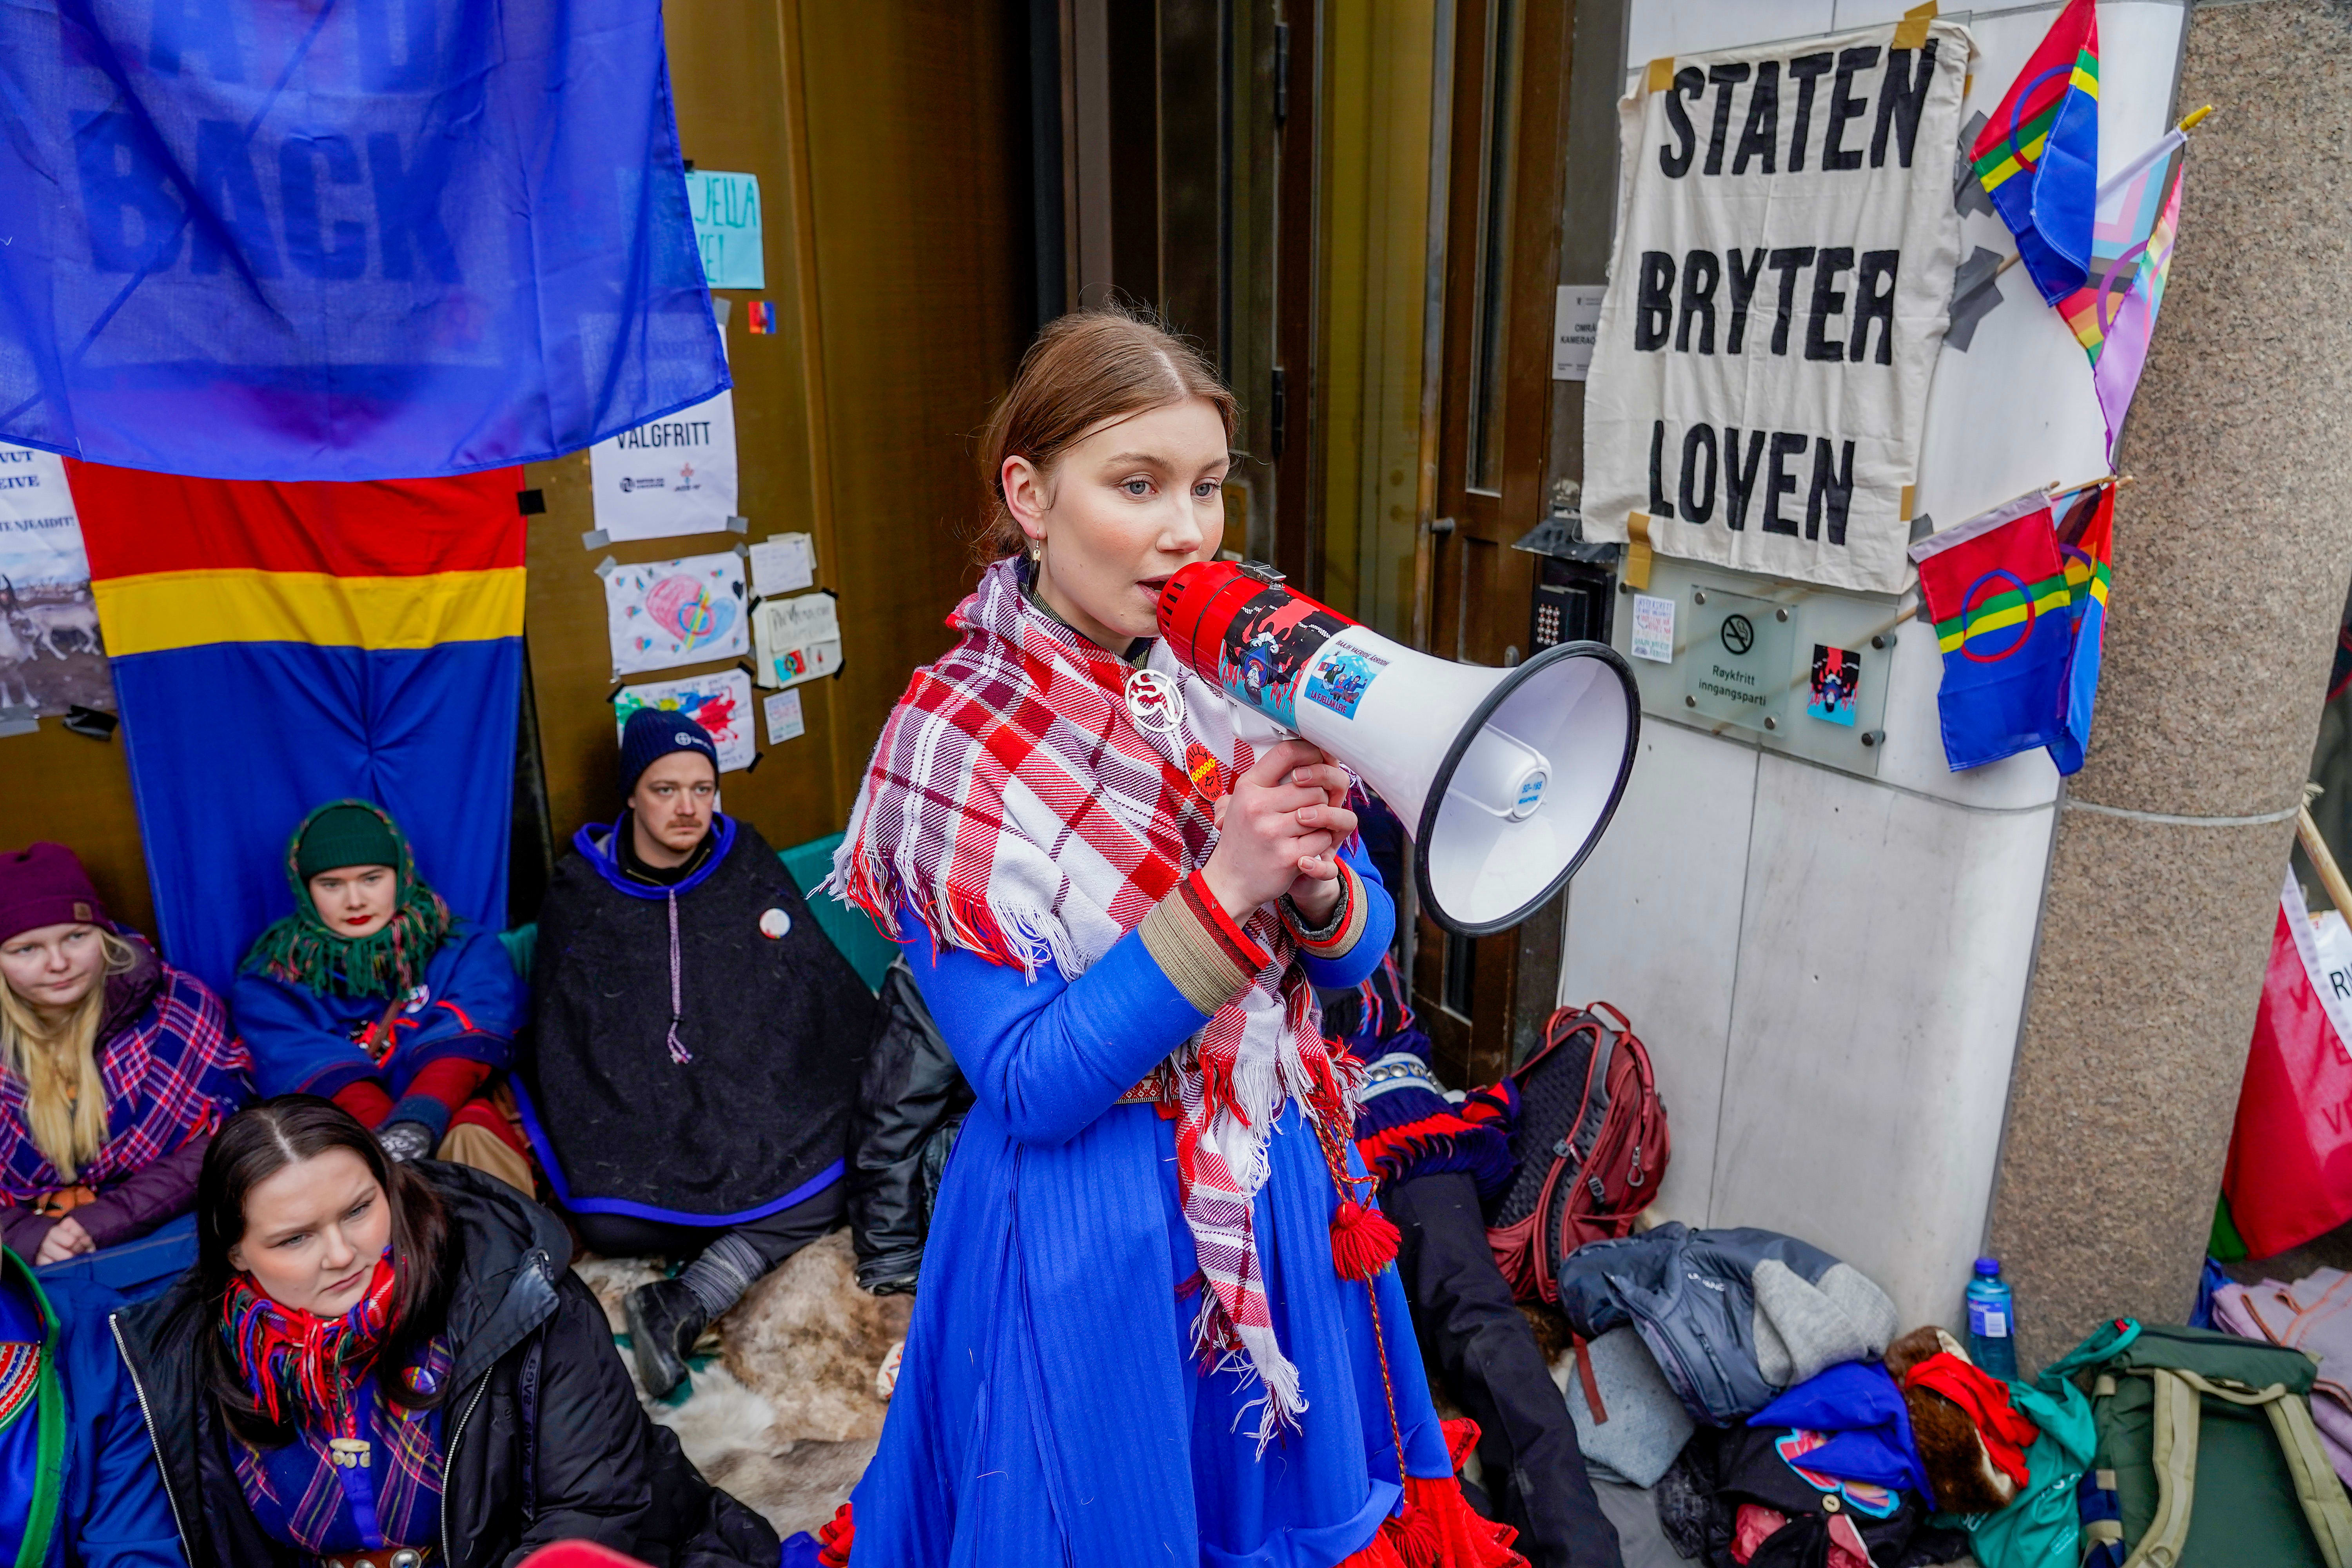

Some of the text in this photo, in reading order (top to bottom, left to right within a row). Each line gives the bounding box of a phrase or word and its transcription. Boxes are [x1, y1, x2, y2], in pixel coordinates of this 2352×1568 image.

[1660, 38, 1939, 179] STATEN
[70, 109, 465, 284] BACK
[1635, 246, 1900, 366] BRYTER
[617, 421, 711, 449] VALGFRITT
[1649, 420, 1855, 546] LOVEN
[1712, 664, 1755, 686] Røykfritt
[1310, 690, 1317, 700] LA
[1335, 702, 1347, 714] LEVE
[1699, 678, 1767, 706] inngangsparti
[1188, 746, 1208, 771] STILLA
[1210, 789, 1221, 799] SKAL
